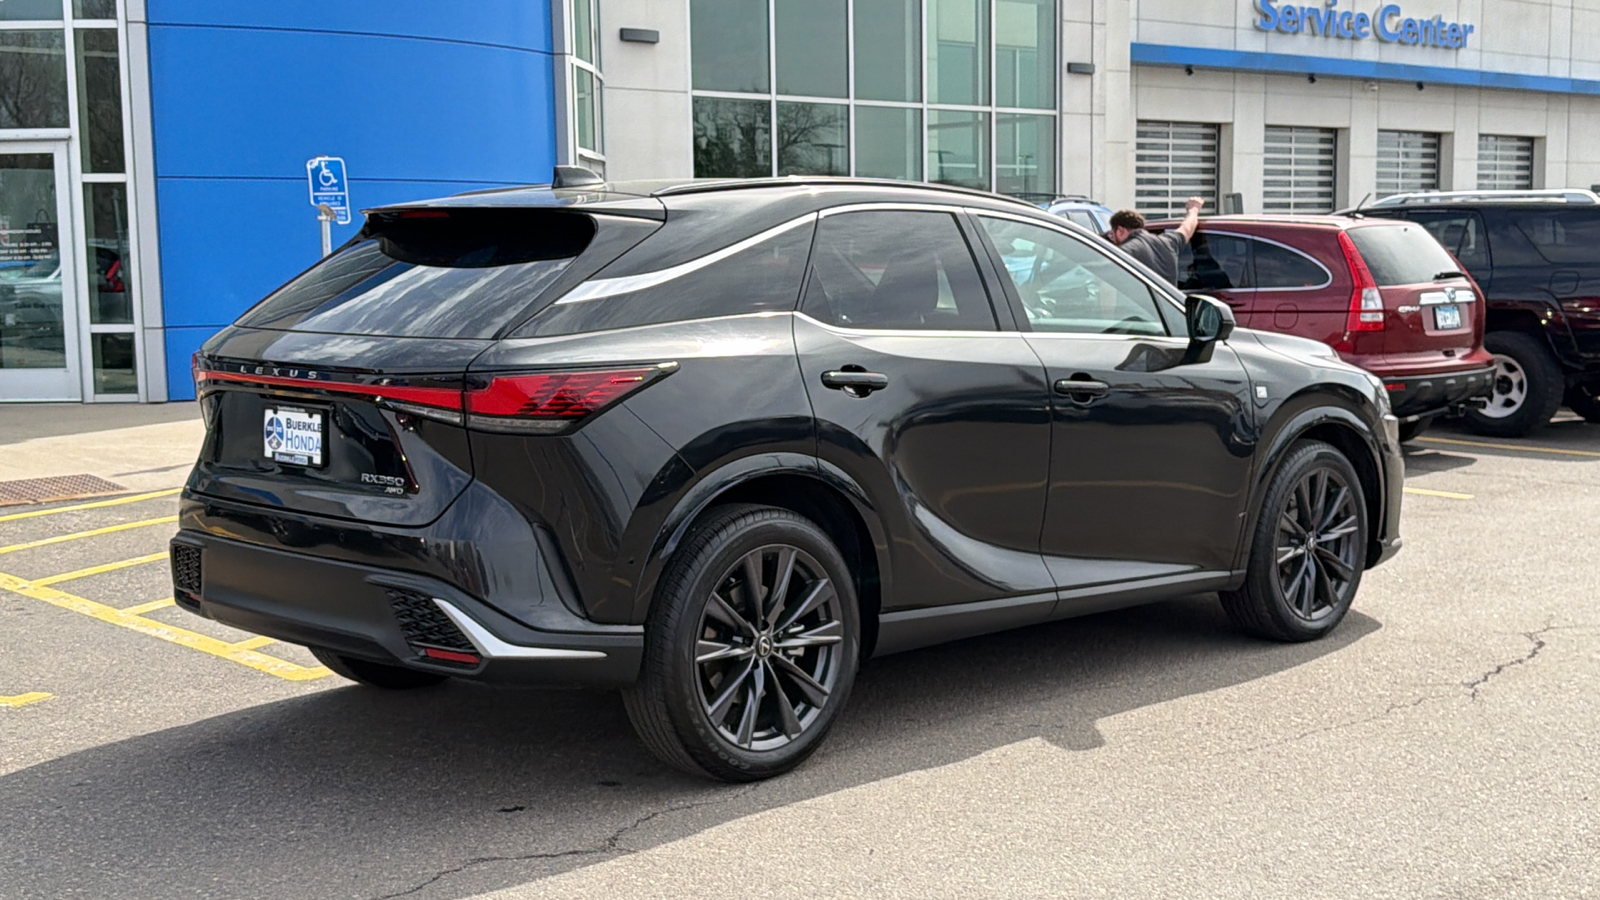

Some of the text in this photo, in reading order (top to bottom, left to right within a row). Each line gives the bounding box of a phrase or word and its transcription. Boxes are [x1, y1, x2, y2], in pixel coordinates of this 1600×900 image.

[1257, 0, 1474, 48] Service Center
[240, 365, 317, 379] LEXUS
[286, 417, 322, 432] BUERKLE
[285, 430, 322, 452] HONDA
[361, 473, 405, 486] RX350
[384, 486, 404, 495] AWD
